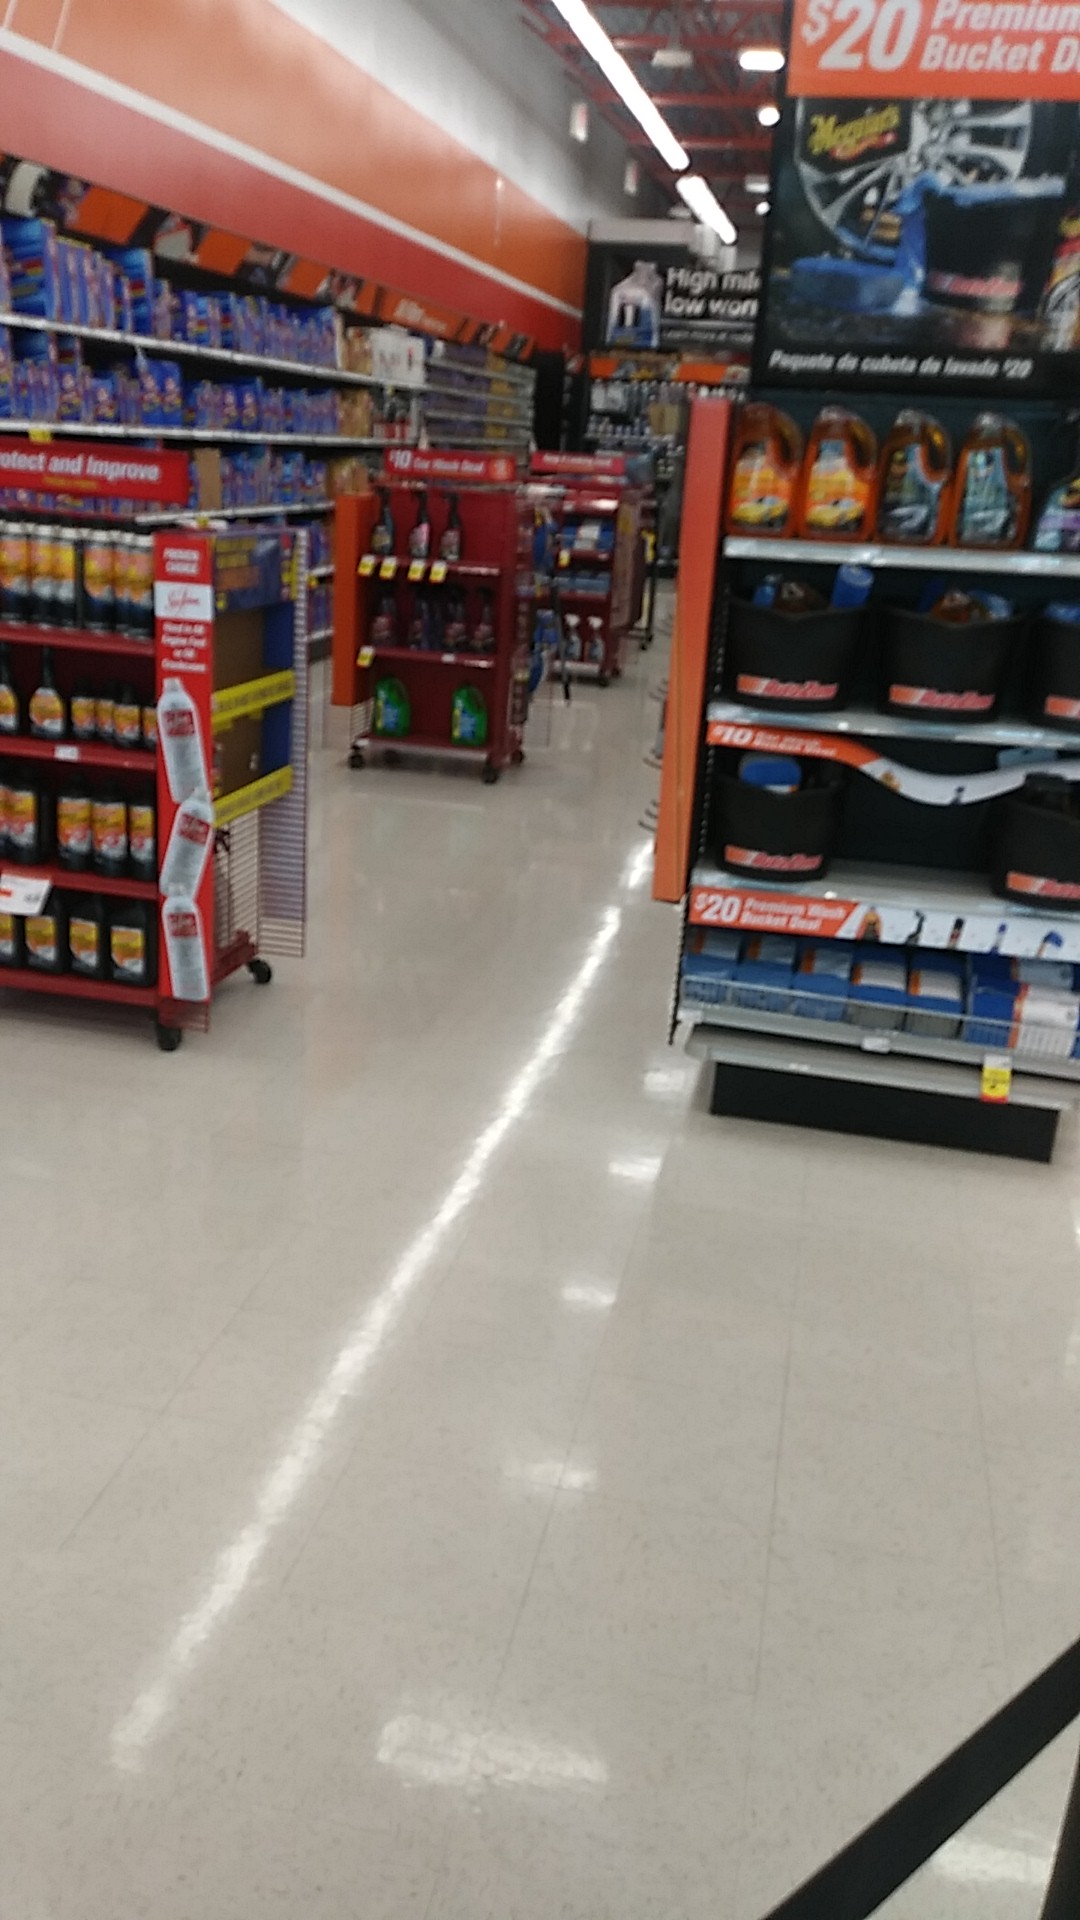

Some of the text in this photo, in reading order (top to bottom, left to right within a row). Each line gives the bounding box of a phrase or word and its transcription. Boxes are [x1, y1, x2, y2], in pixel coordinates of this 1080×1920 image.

[801, 0, 921, 71] $20
[919, 34, 1045, 72] Bucket
[665, 290, 706, 314] low
[48, 453, 84, 475] and
[711, 724, 753, 746] $10
[694, 892, 742, 924] $20
